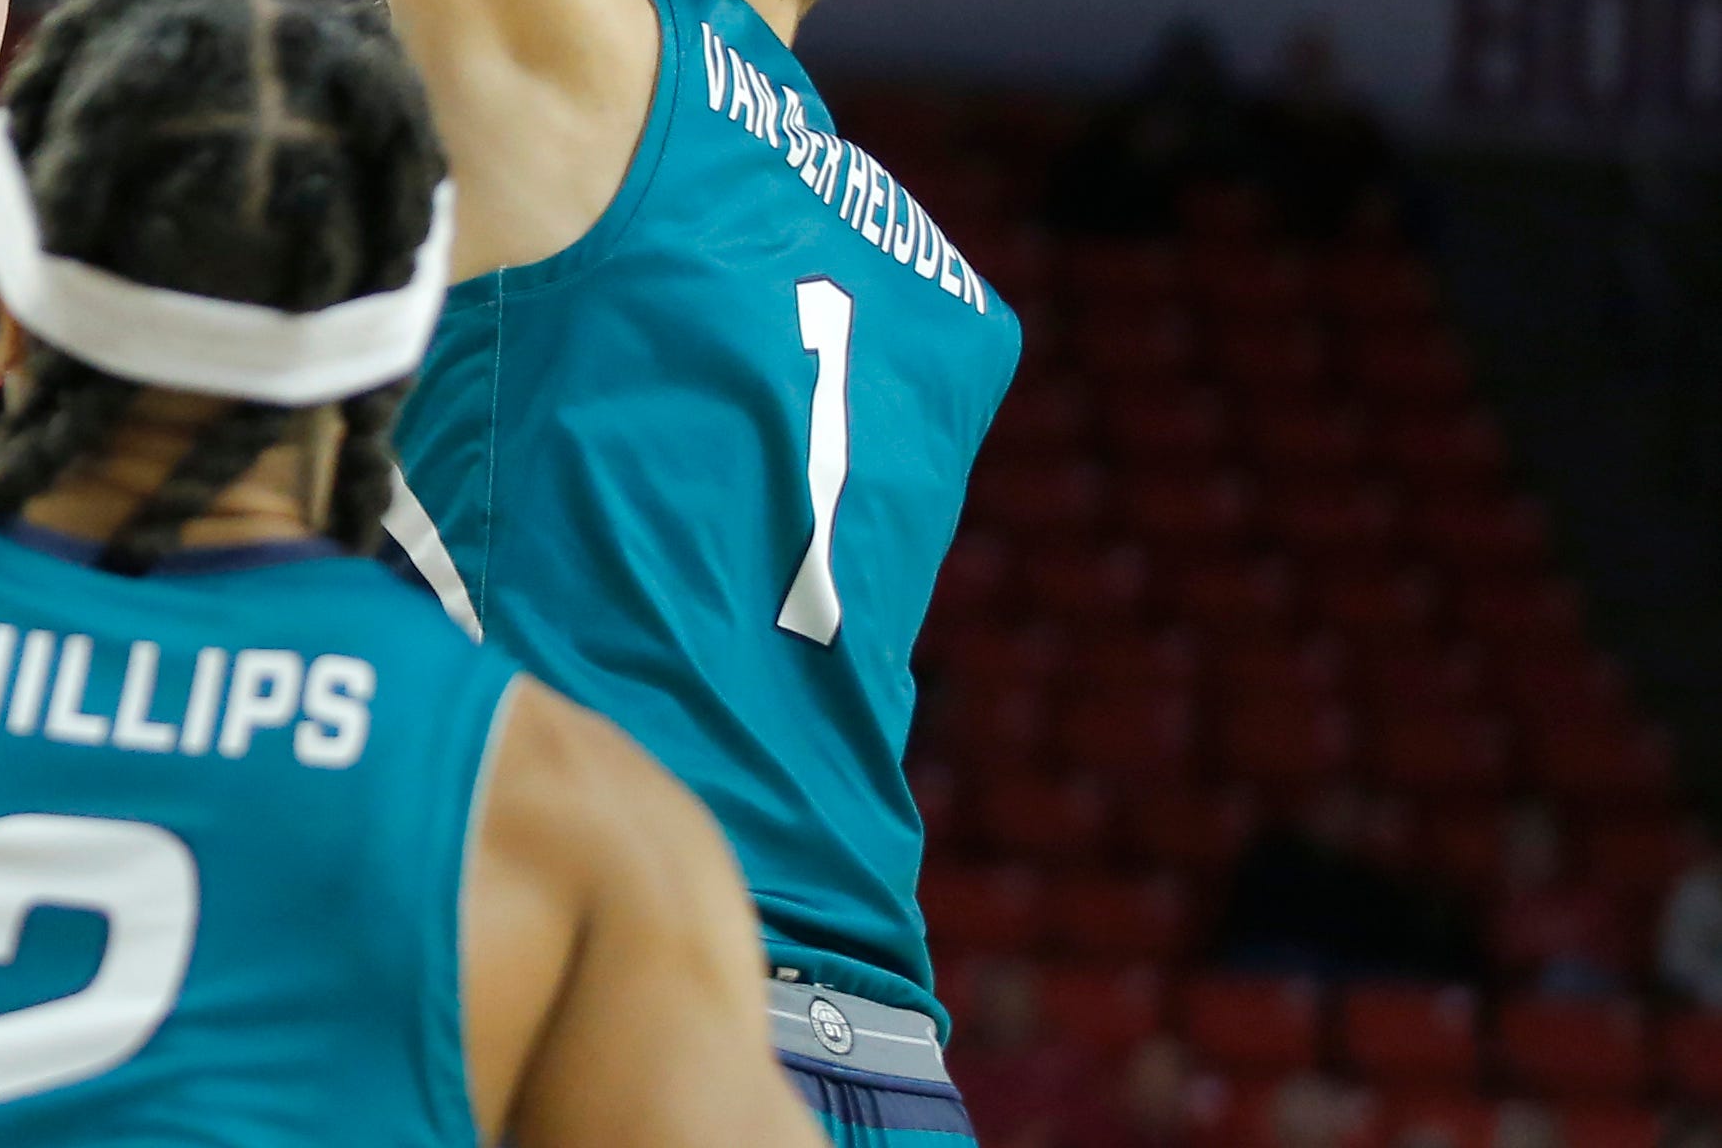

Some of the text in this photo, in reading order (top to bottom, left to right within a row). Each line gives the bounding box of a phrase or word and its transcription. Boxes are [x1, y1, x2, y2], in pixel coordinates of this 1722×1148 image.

[700, 21, 779, 149] VAN
[838, 138, 986, 315] HEIJDEN
[776, 276, 854, 648] 1
